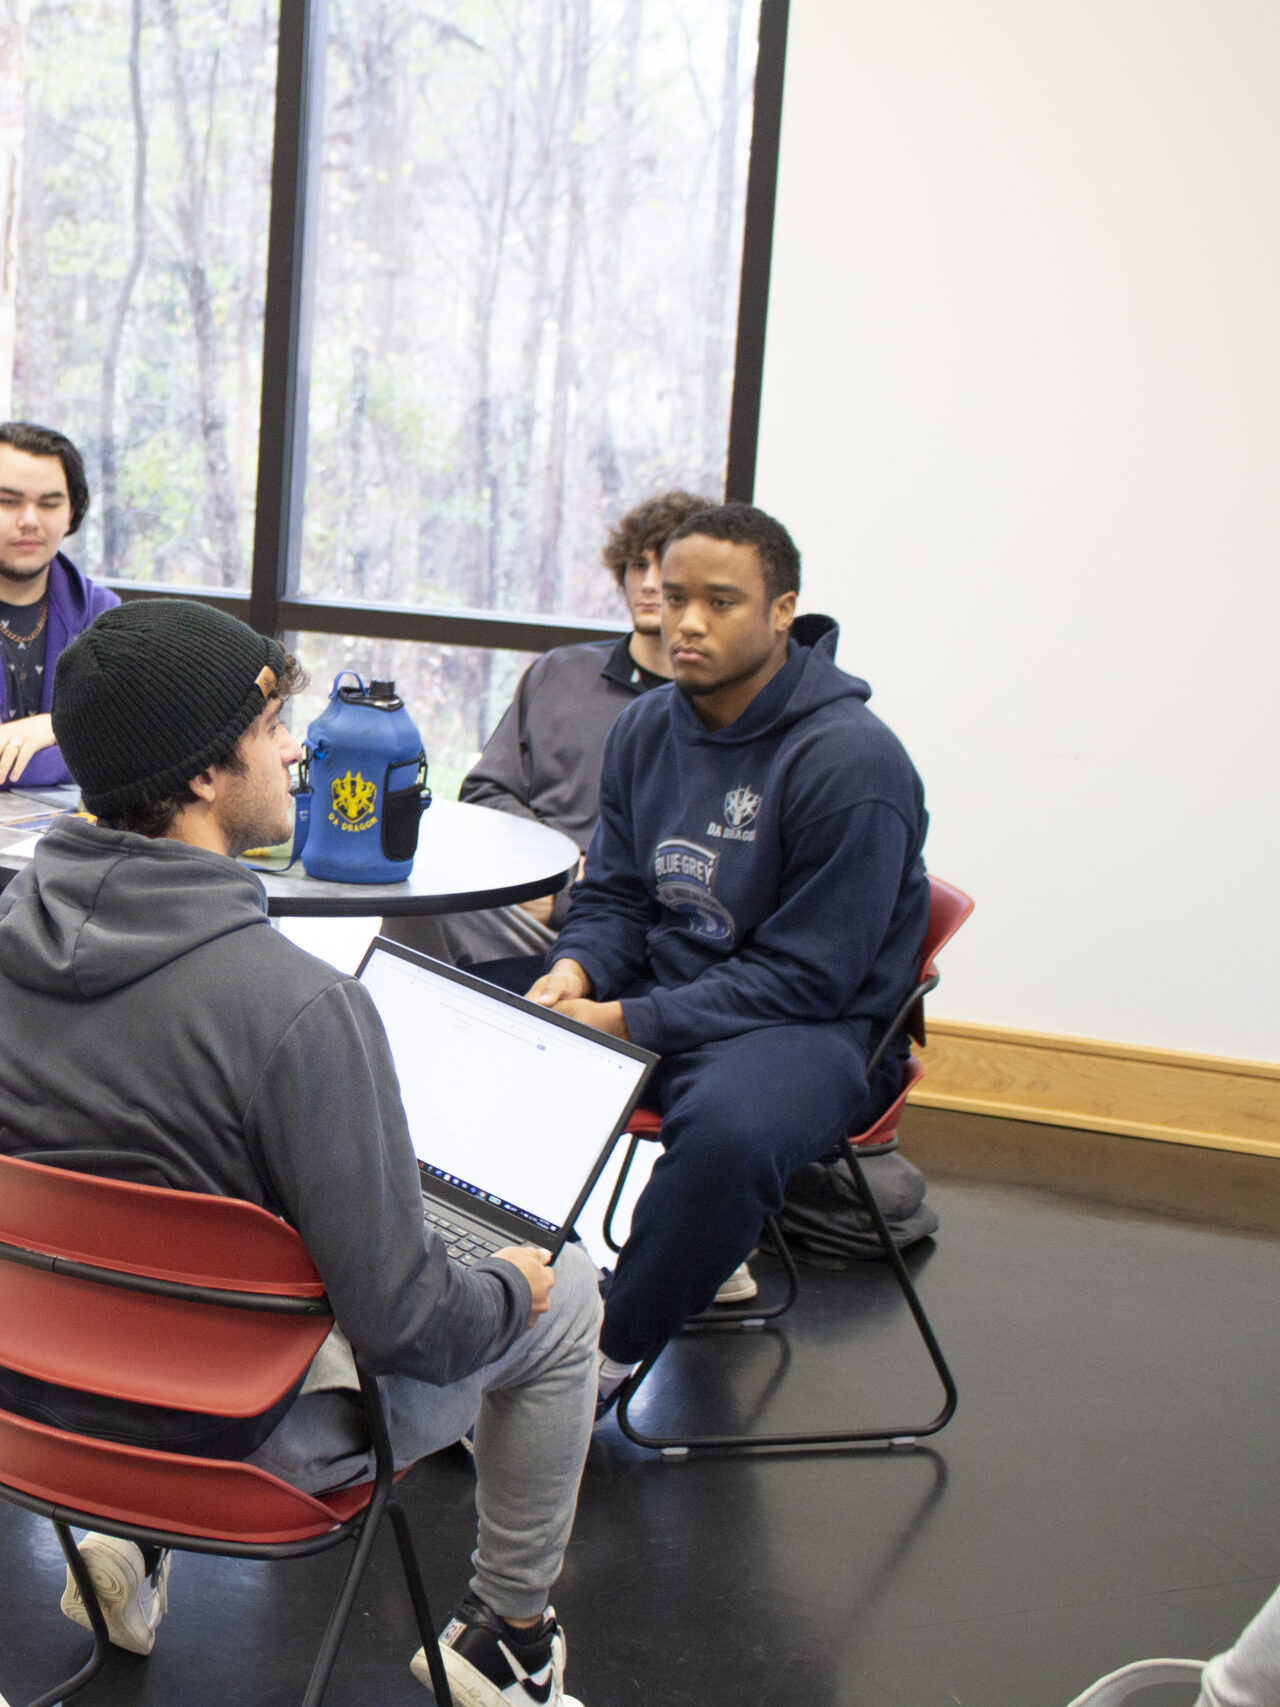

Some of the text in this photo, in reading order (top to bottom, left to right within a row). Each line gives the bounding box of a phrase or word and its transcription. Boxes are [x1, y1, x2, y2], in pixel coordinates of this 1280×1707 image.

[341, 816, 378, 833] DRAGON
[706, 821, 722, 837] DA
[655, 853, 714, 886] BLUE-GREY
